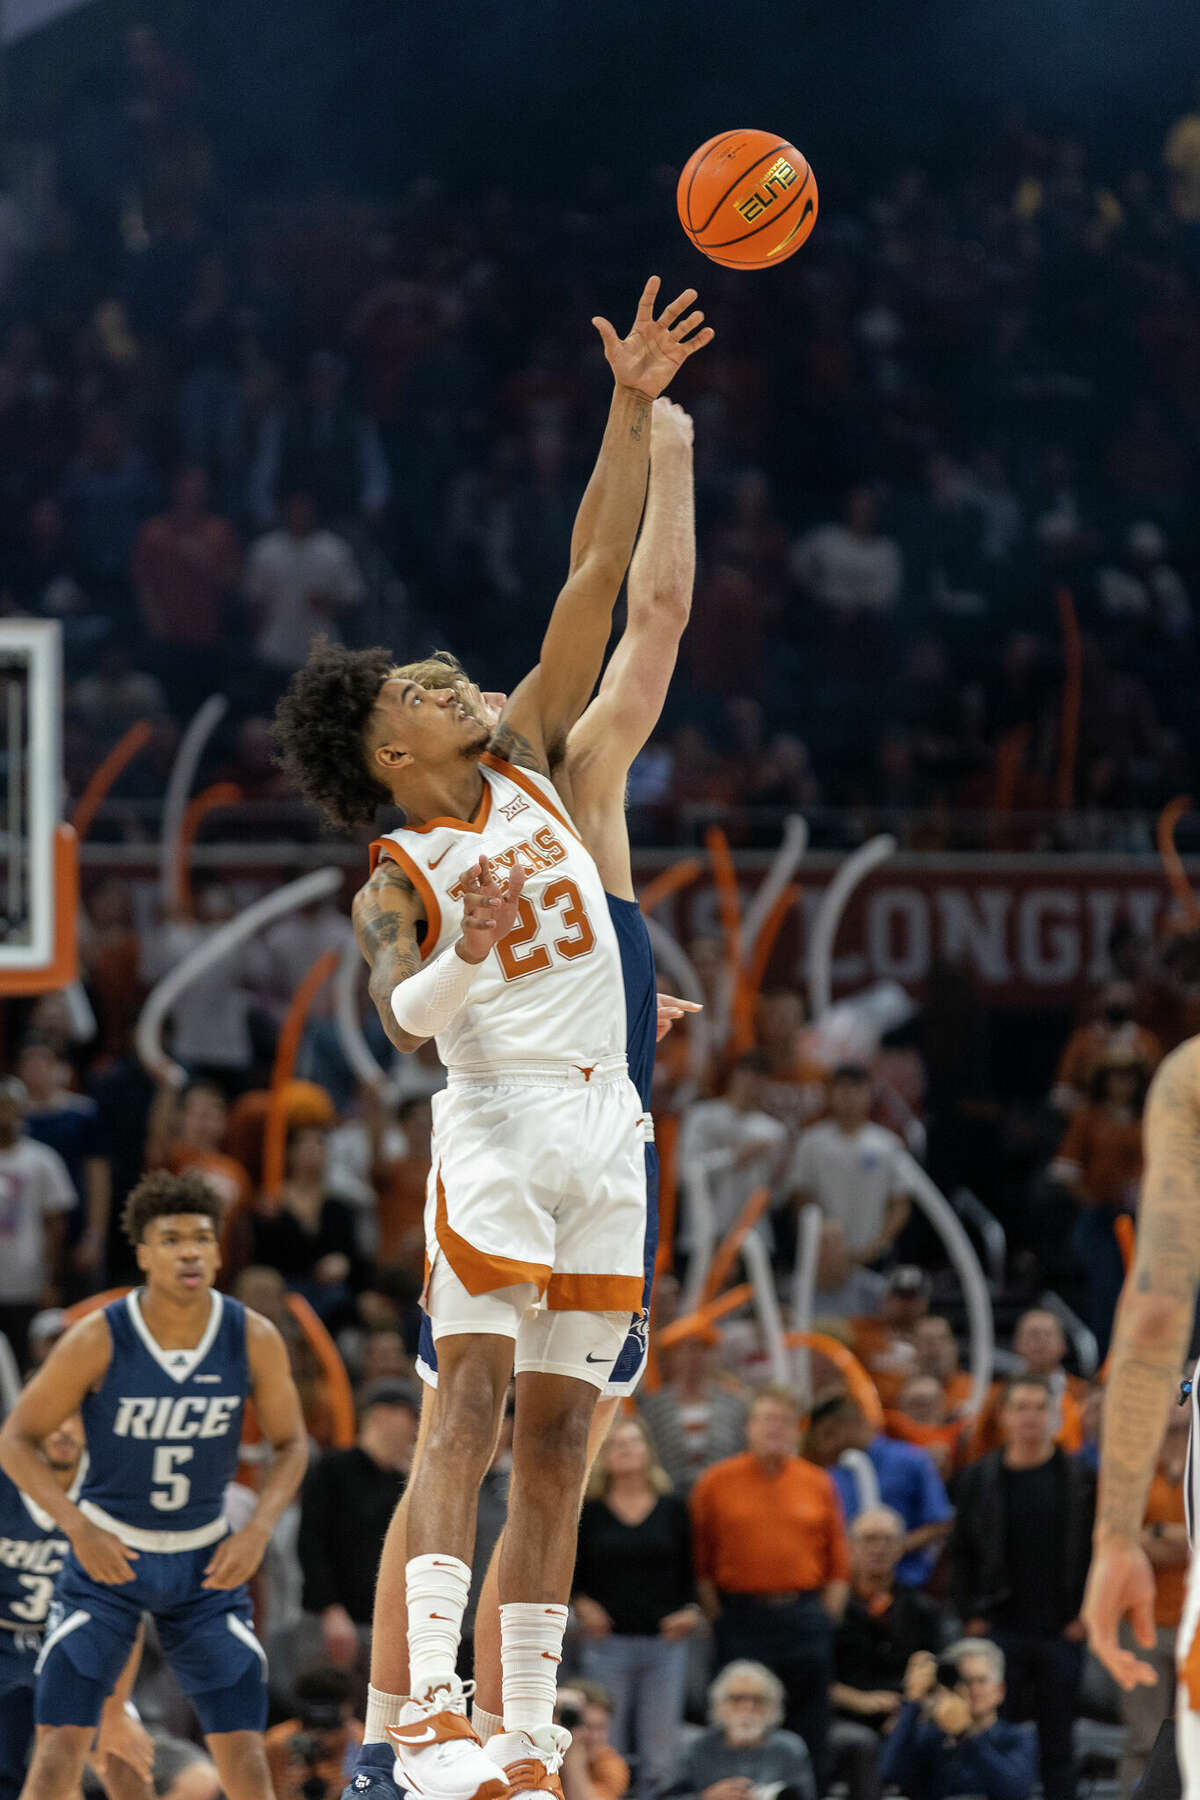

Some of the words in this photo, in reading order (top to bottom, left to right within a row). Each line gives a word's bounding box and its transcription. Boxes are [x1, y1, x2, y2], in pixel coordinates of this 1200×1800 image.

[737, 162, 799, 224] ELITE
[446, 824, 569, 902] XAS
[494, 875, 597, 983] 23
[113, 1395, 240, 1439] RICE
[150, 1446, 194, 1511] 5
[9, 1573, 54, 1622] 3
